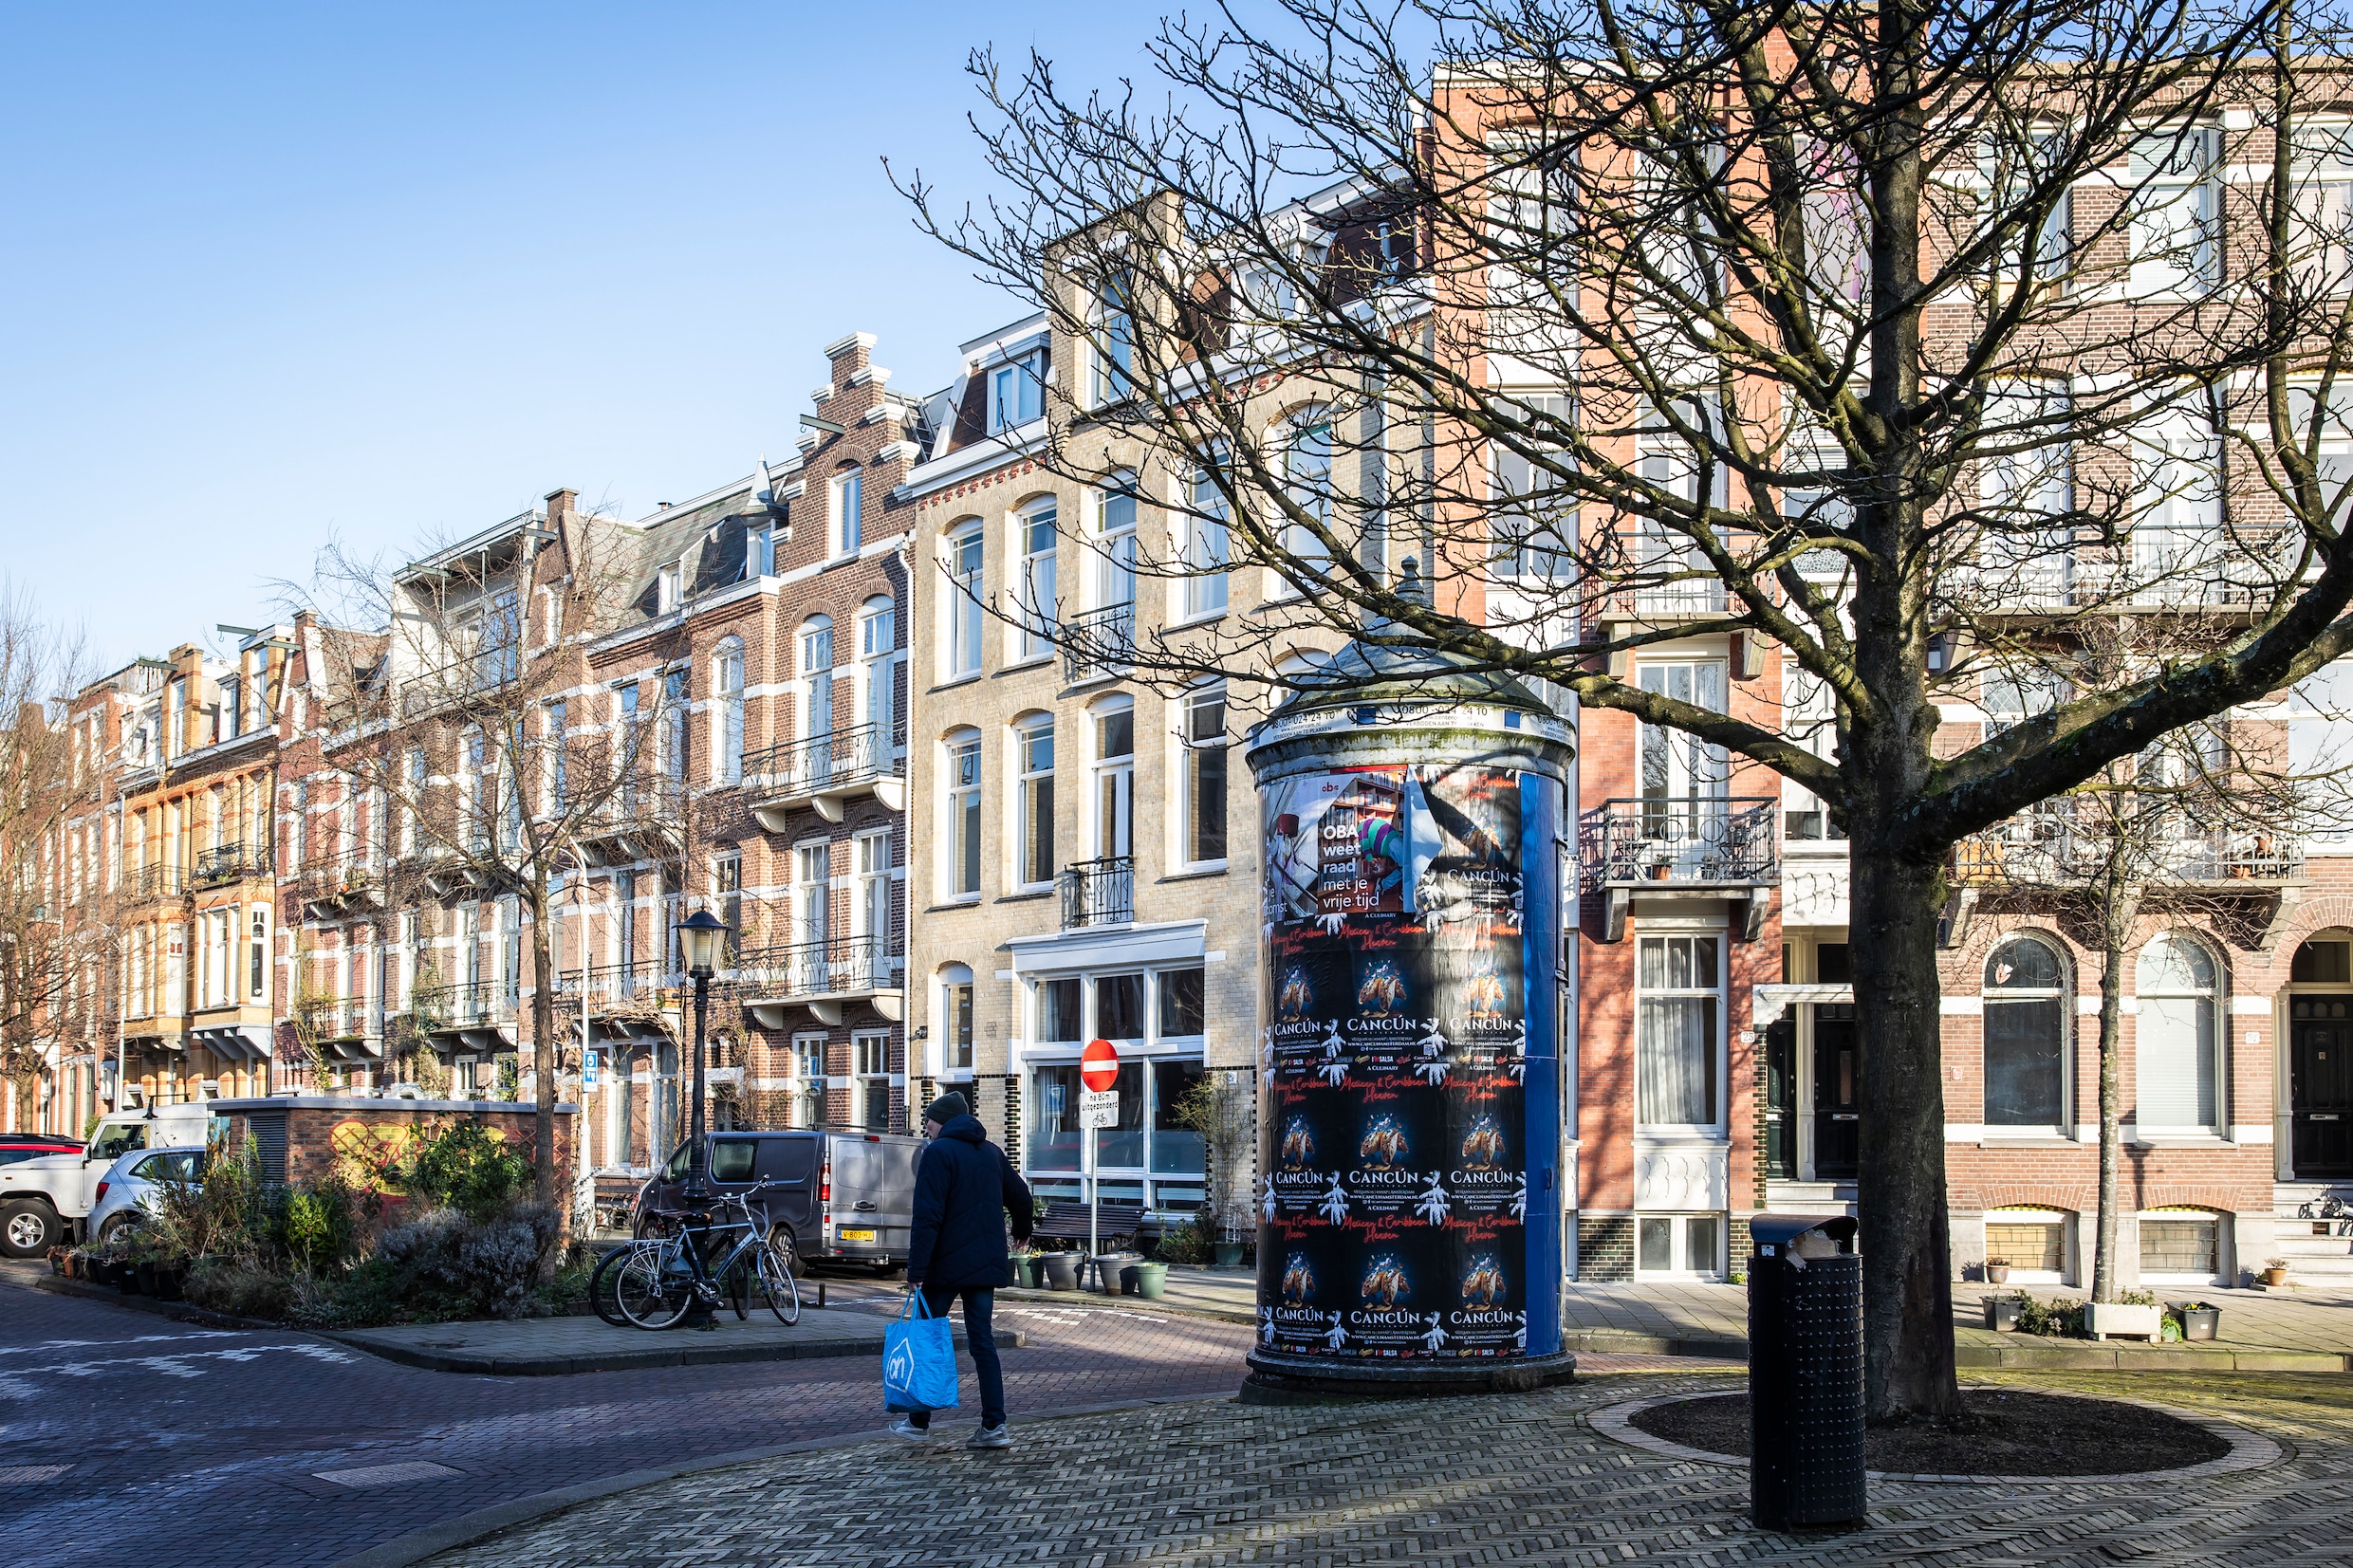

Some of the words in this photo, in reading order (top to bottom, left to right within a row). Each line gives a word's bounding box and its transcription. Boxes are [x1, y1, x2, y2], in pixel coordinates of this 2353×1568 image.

[1401, 705, 1429, 714] 0800
[1476, 707, 1488, 716] 10
[1323, 824, 1359, 839] OBA
[1323, 843, 1362, 857] weet
[1324, 858, 1356, 874] raad
[1324, 877, 1351, 891] met
[1353, 876, 1368, 893] je
[1323, 895, 1352, 911] vrije
[1355, 892, 1380, 910] tijd
[1361, 934, 1397, 951] Heaven
[1274, 1017, 1321, 1036] CANCÚN
[1347, 1014, 1417, 1031] CANCÚN
[1340, 1075, 1377, 1091] Mexican
[1384, 1075, 1428, 1091] Caribbean
[1362, 1087, 1399, 1103] Heaven
[1082, 1100, 1119, 1113] uitgezonderd
[1276, 1168, 1324, 1184] CANCÚN
[1349, 1168, 1418, 1184] CANCÚN
[1450, 1168, 1513, 1184] CANCÚN
[1341, 1214, 1376, 1230] Mexican
[1385, 1214, 1428, 1229] Caribbean
[1363, 1227, 1399, 1243] Heaven
[1276, 1305, 1324, 1321] CANCÚN
[1350, 1308, 1420, 1324] CANCÚN
[1450, 1307, 1513, 1324] CANCÚN
